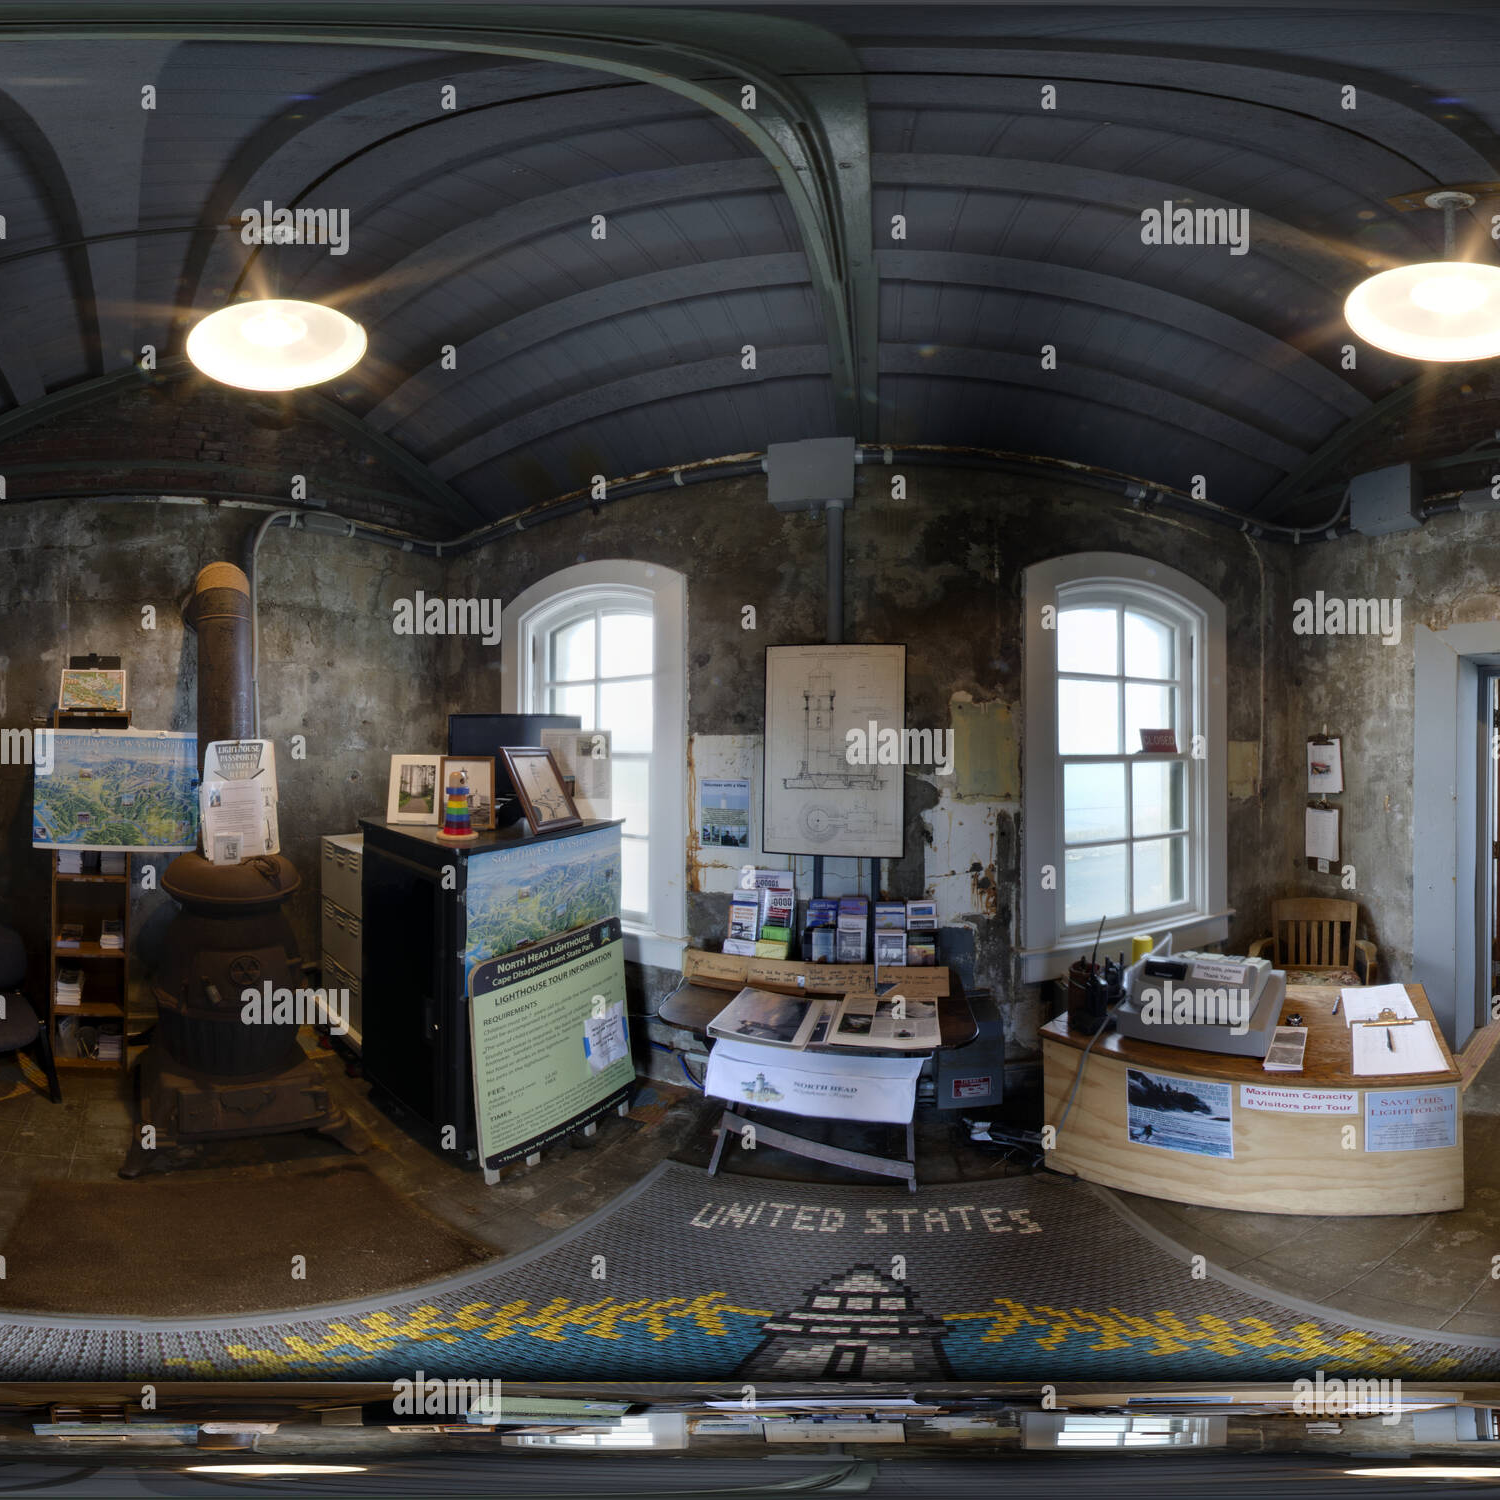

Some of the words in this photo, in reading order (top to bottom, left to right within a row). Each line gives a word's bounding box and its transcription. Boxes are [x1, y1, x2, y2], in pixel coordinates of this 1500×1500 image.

[218, 744, 260, 754] LIGHTHOUSE
[497, 957, 526, 974] NORTH
[528, 949, 549, 963] HEAD
[550, 932, 590, 955] LIGHTHOUSE
[492, 975, 512, 987] Cape
[512, 955, 566, 979] Disappointment
[566, 948, 582, 959] State
[582, 942, 595, 953] Park
[494, 980, 548, 1007] LIGHTHOUSE
[548, 970, 568, 985] TOUR
[569, 951, 612, 977] INFORMATION
[484, 1001, 538, 1026] REQUIREMENTS
[487, 1086, 506, 1097] FEES
[794, 1081, 828, 1091] NORTH
[830, 1085, 858, 1093] HEAD
[1246, 1088, 1299, 1098] Maximum
[1302, 1092, 1353, 1100] Capacity
[1256, 1100, 1299, 1109] Visitors
[1380, 1098, 1410, 1106] SAVE
[1416, 1096, 1444, 1104] THIS
[490, 1110, 512, 1122] TIMES
[1371, 1104, 1453, 1116] LIGHTHOUSE!
[689, 1202, 845, 1232] UNITED
[863, 1205, 1043, 1234] STATES
